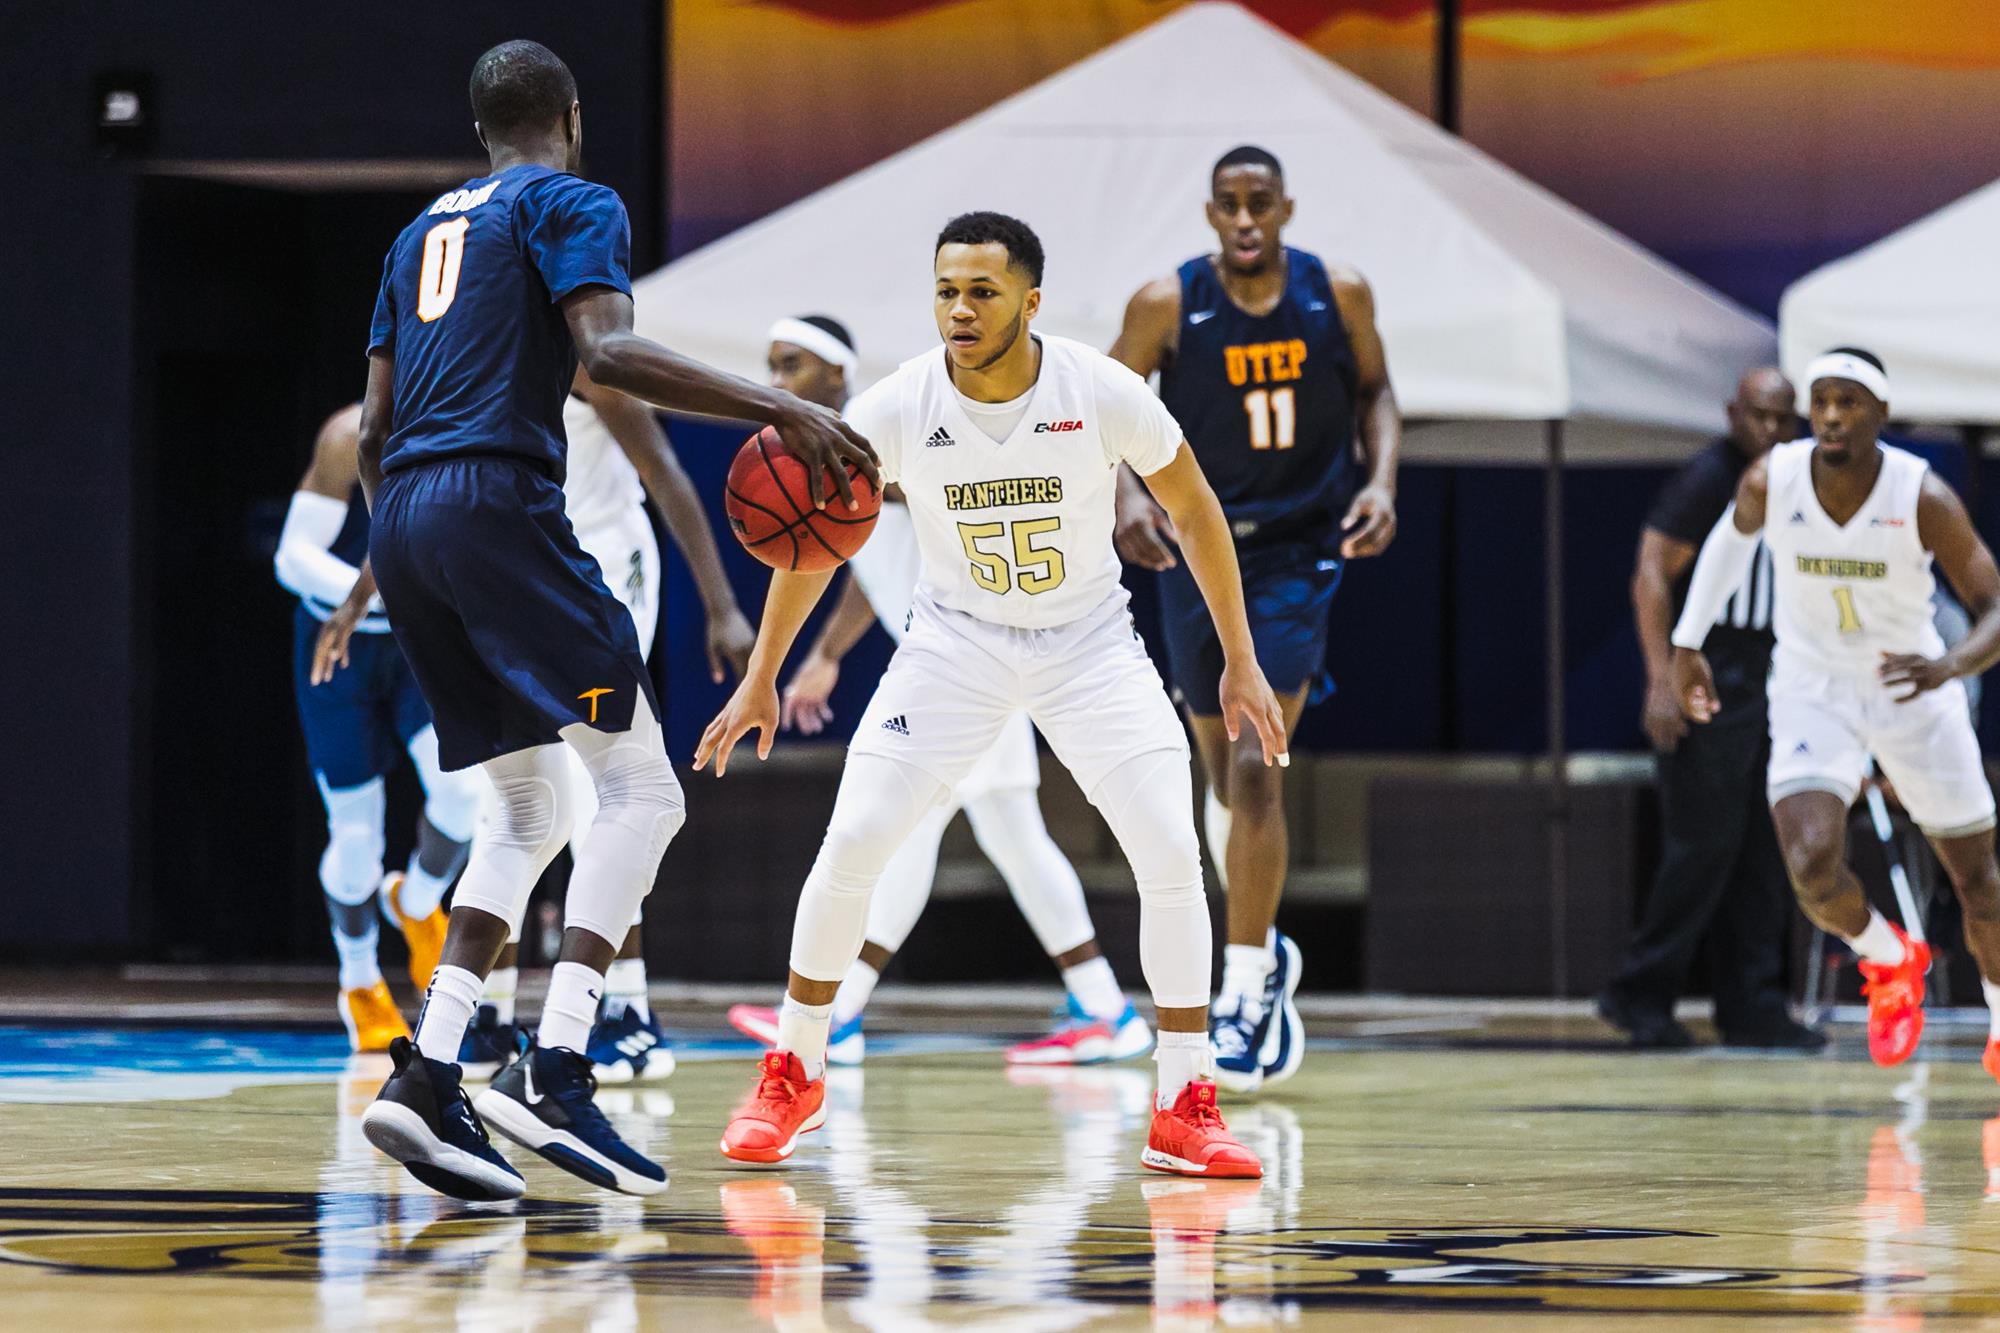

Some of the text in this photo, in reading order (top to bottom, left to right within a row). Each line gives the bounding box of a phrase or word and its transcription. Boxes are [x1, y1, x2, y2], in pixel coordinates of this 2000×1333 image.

[417, 216, 470, 323] 0
[1224, 339, 1307, 386] UTEP
[1243, 387, 1295, 450] 11
[926, 439, 956, 448] adidas
[944, 477, 1063, 510] PANTHERS
[957, 516, 1065, 595] 55
[1832, 586, 1862, 634] 1
[881, 722, 910, 736] adidas
